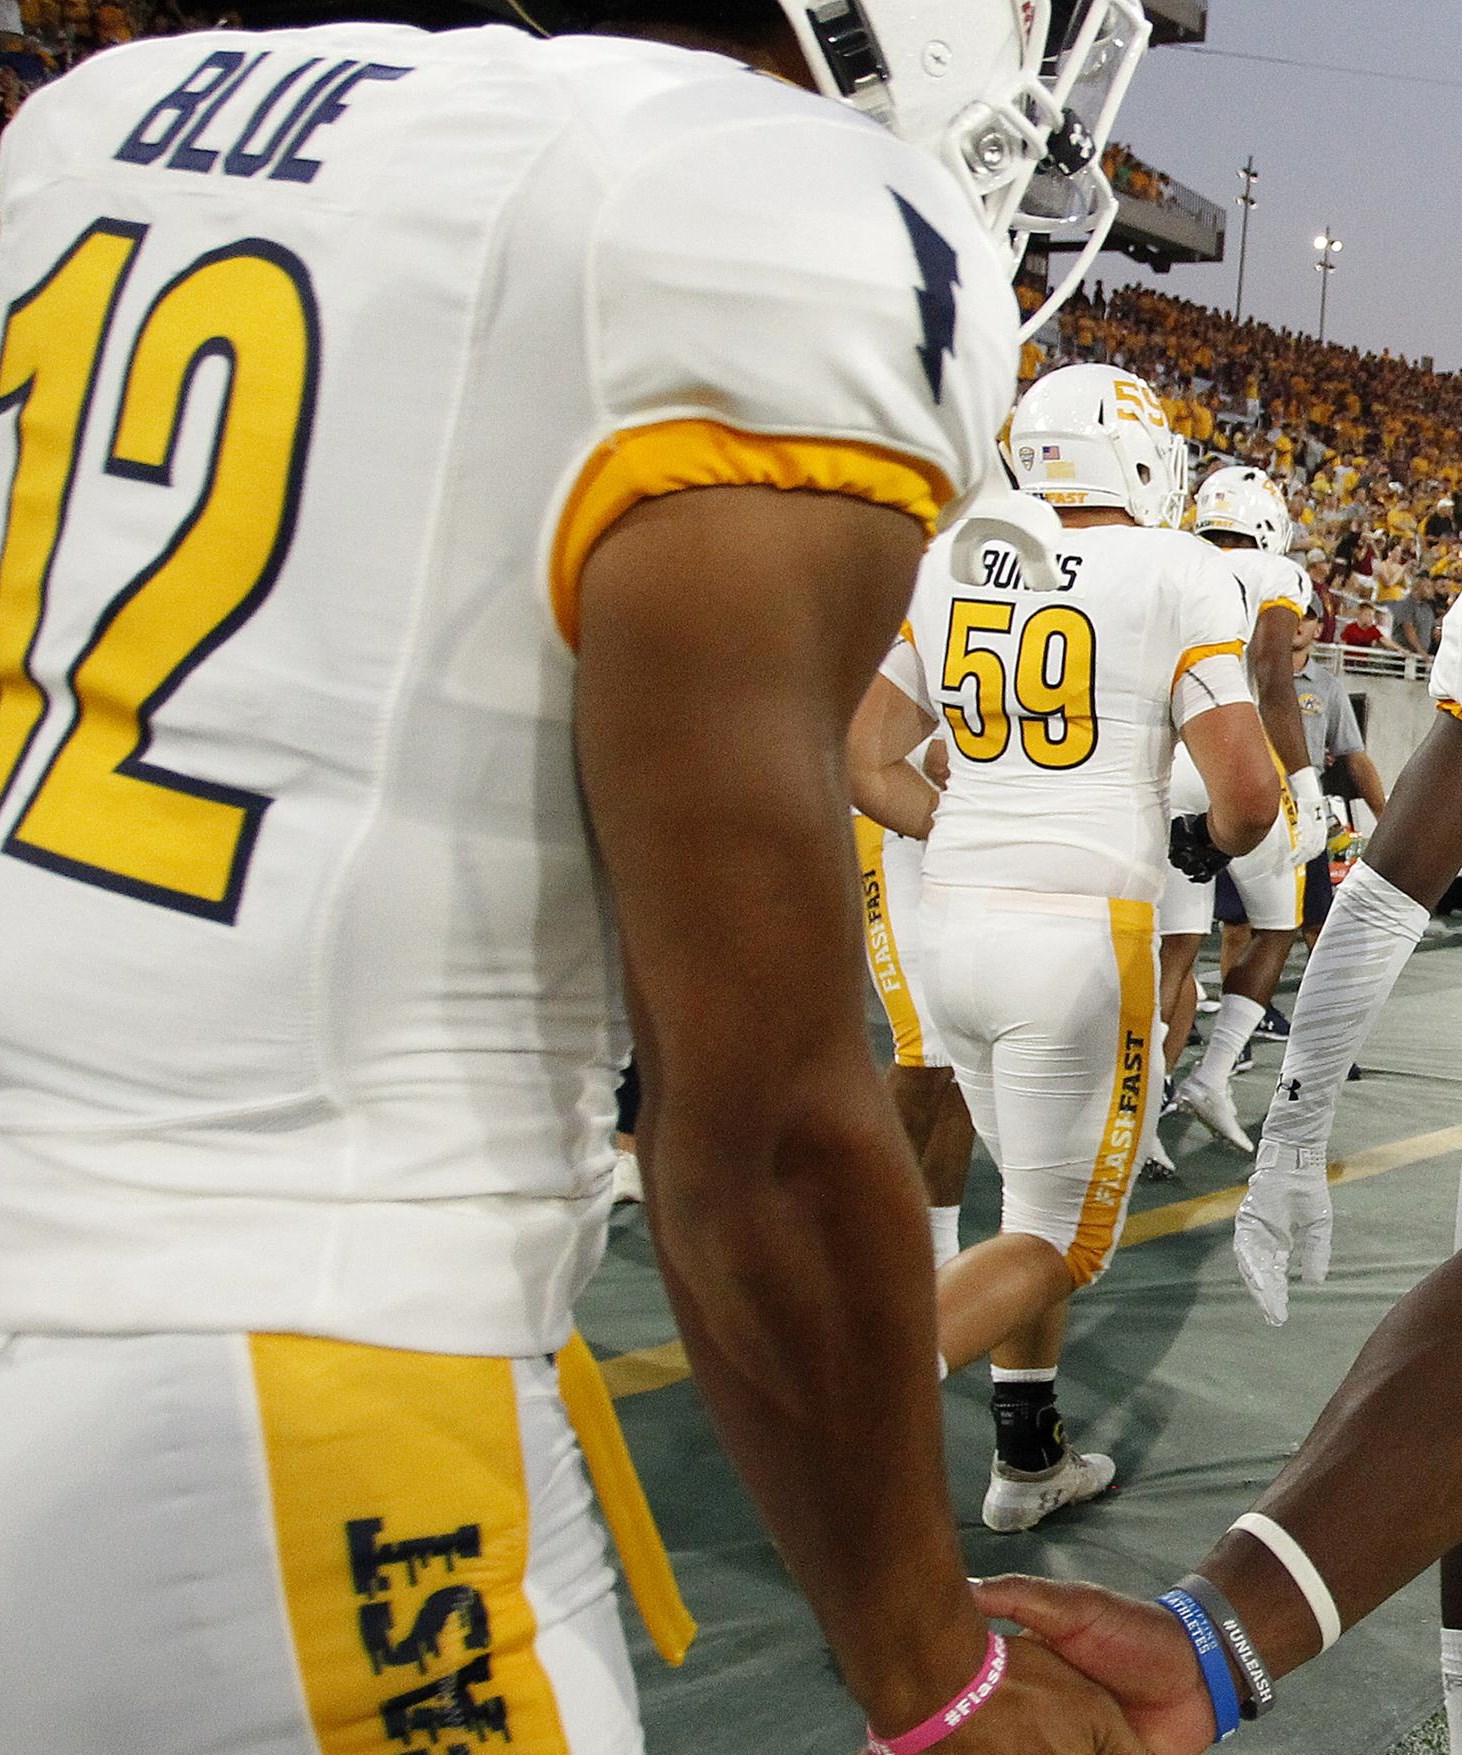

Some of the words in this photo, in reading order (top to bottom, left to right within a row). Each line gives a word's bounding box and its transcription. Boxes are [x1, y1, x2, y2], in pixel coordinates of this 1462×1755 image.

[113, 50, 417, 183] BLUE
[0, 216, 321, 926] 12
[981, 550, 1083, 592] BUS
[941, 597, 1099, 770] 59
[1223, 1619, 1273, 1703] #UNLEASH
